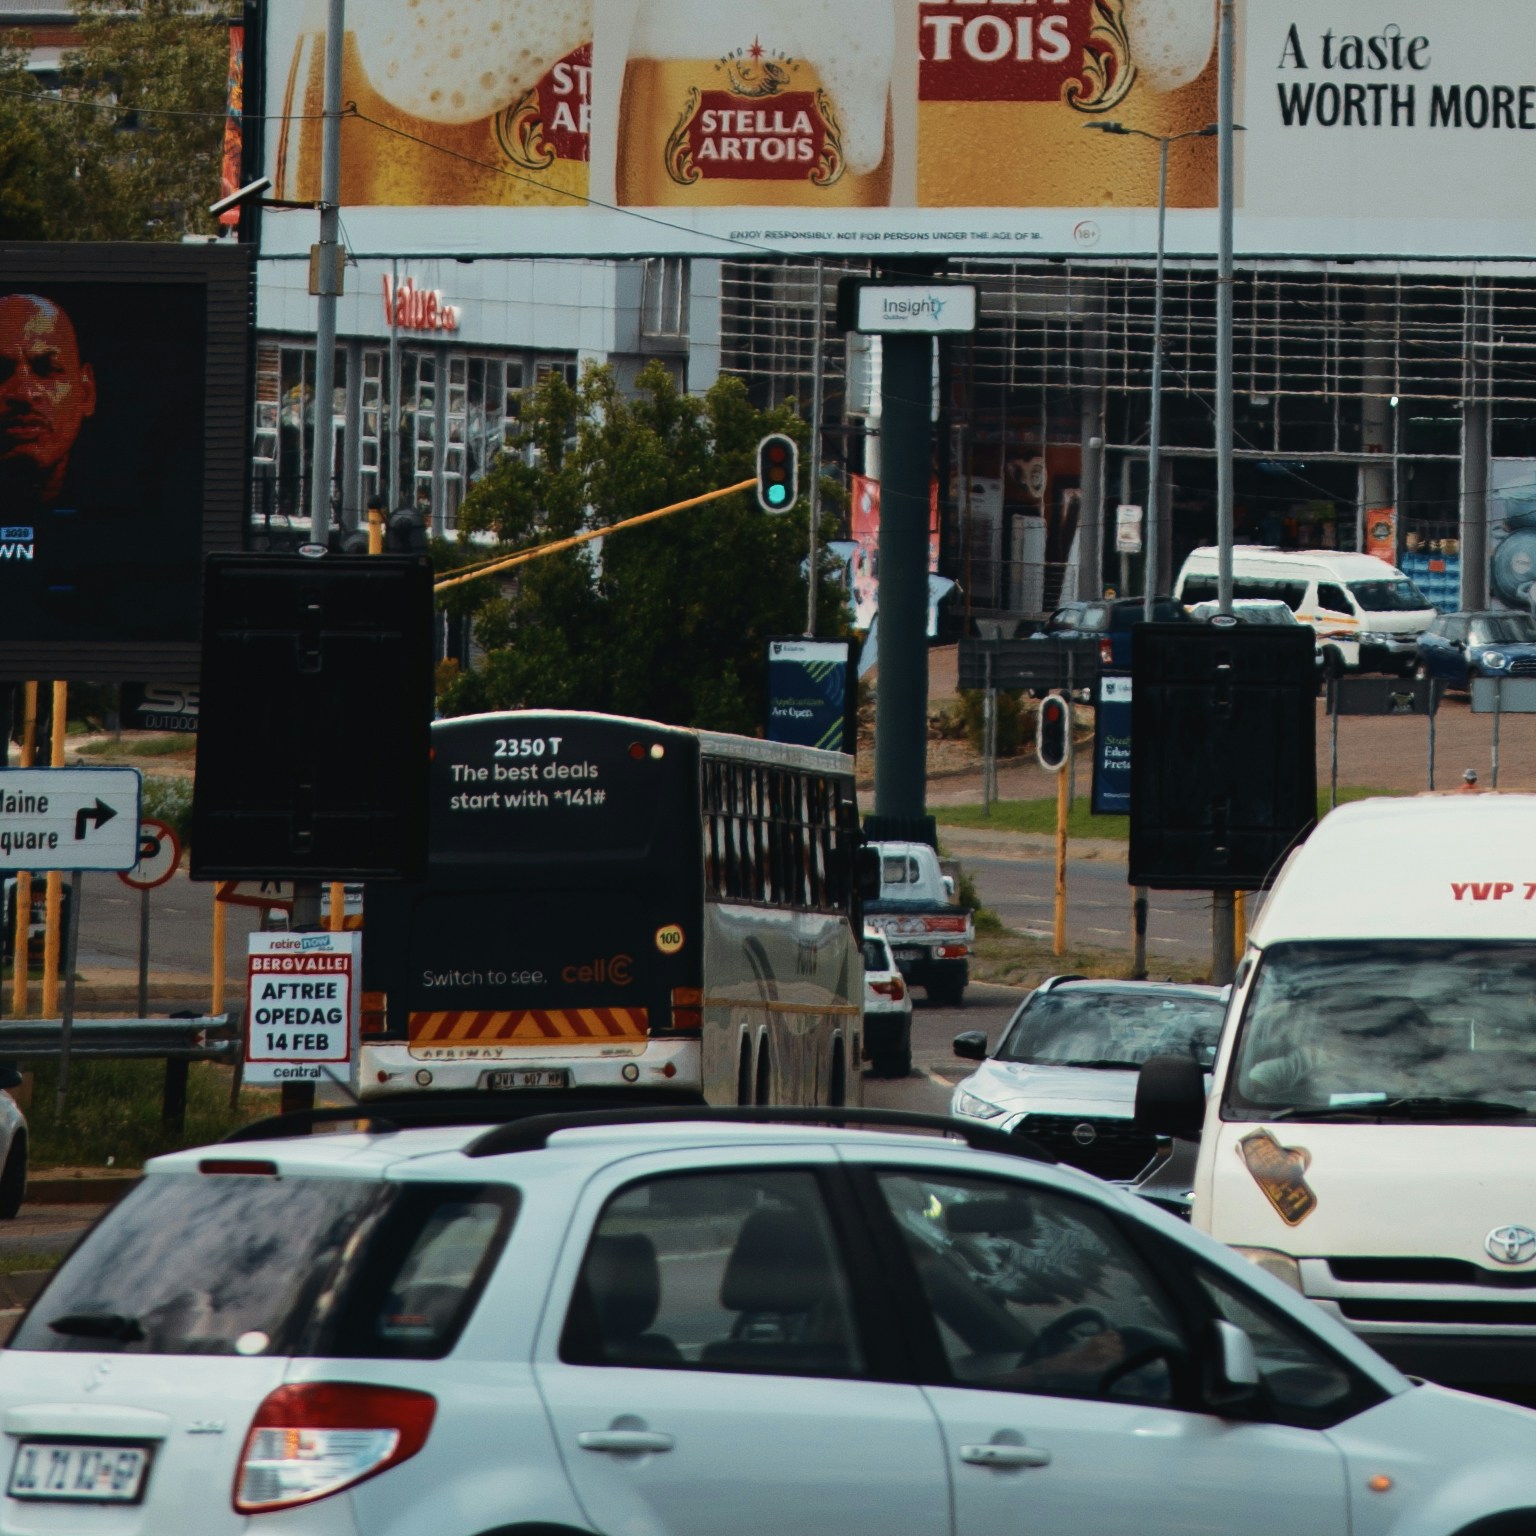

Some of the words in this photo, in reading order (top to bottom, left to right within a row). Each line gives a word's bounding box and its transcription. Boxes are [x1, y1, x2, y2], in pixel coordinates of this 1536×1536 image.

[919, 15, 1071, 62] TOIS
[1277, 22, 1308, 69] A
[1320, 23, 1431, 70] taste
[1277, 82, 1415, 127] WORTH
[702, 109, 814, 134] STELLA
[697, 137, 815, 162] ARTOIS
[730, 230, 761, 240] ENJOY
[764, 230, 835, 241] RESPONSIBLY.
[837, 231, 857, 241] NOT
[860, 231, 881, 241] FOR
[883, 231, 930, 241] PERSONS
[932, 231, 967, 241] UNDER
[1015, 231, 1028, 241] OF
[883, 298, 936, 317] Insight
[145, 714, 199, 731] OUTDOO
[494, 738, 546, 757] 2350
[549, 737, 563, 756] T
[451, 764, 489, 782] The
[494, 763, 539, 780] best
[543, 760, 599, 779] deals
[0, 789, 48, 814] aine
[450, 791, 500, 809] start
[504, 789, 549, 808] with
[1451, 882, 1514, 901] YVP
[270, 937, 301, 949] retire
[660, 931, 681, 944] 100
[251, 956, 349, 972] BERGVALLEI
[422, 969, 483, 987] Switch
[487, 969, 507, 985] to
[510, 969, 548, 985] see.
[261, 982, 338, 1001] AFTREE
[255, 1007, 343, 1026] OPEDAG
[266, 1032, 289, 1051] 14
[292, 1032, 330, 1051] FEB
[273, 1064, 322, 1079] central
